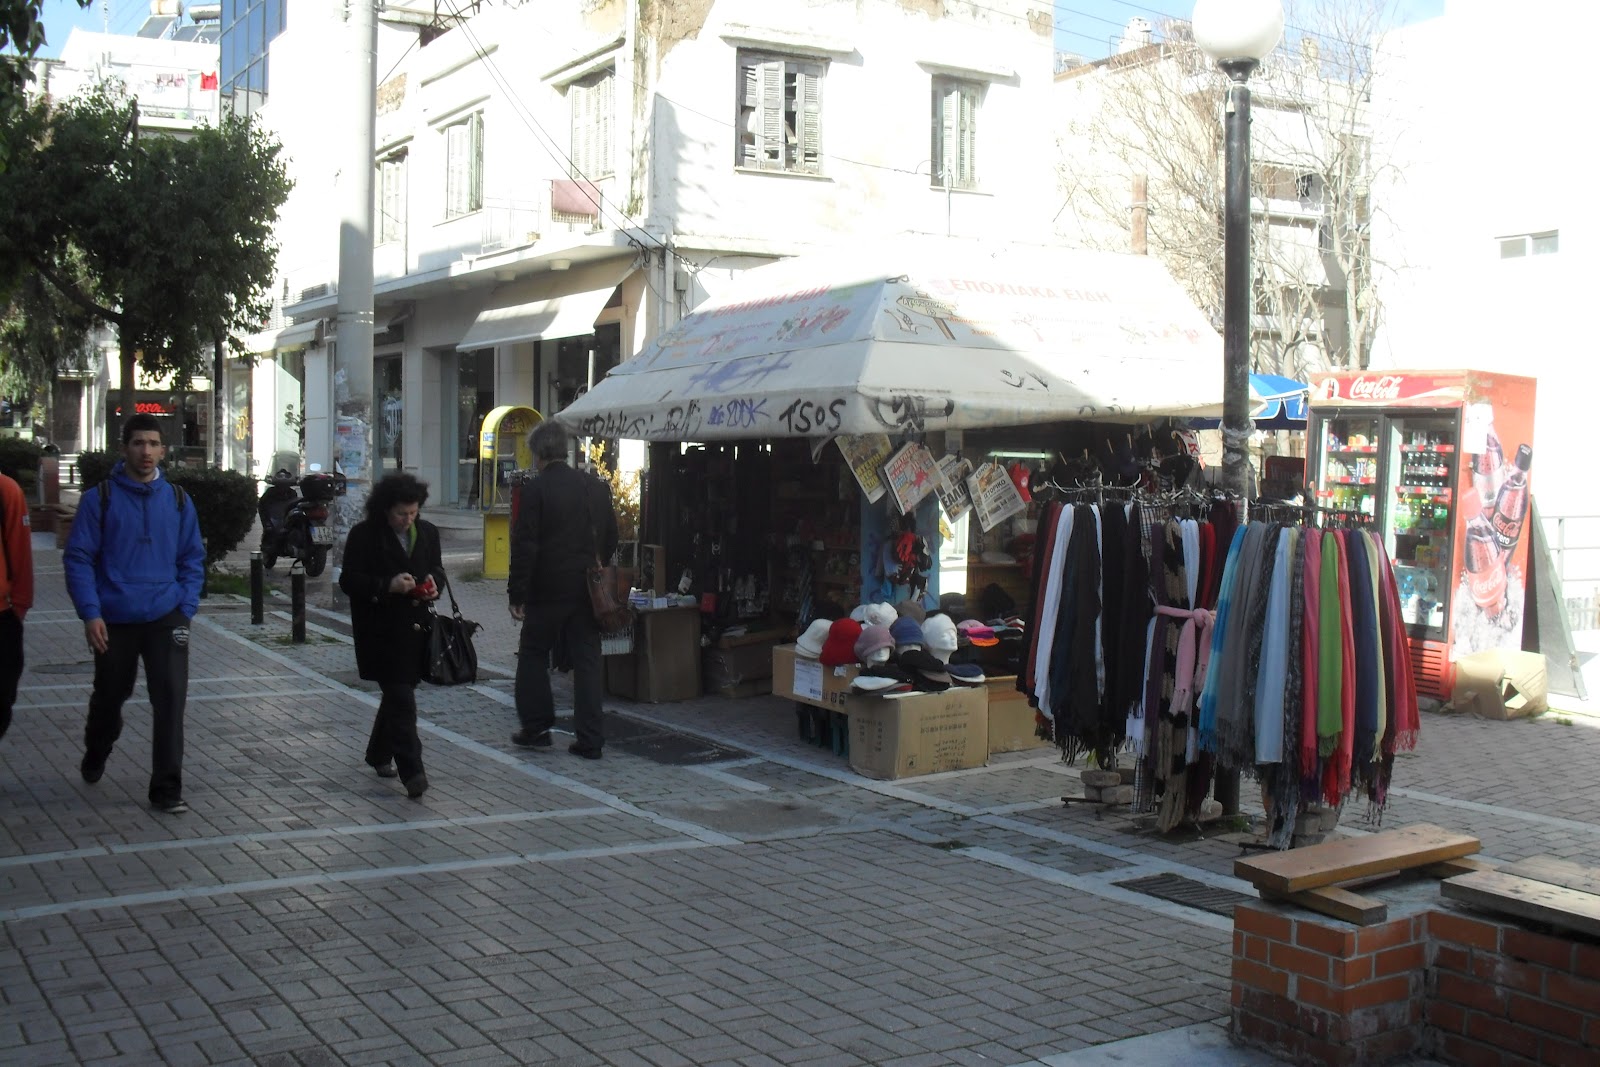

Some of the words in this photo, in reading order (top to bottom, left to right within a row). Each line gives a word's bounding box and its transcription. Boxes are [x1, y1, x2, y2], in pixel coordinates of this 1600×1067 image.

[949, 279, 1057, 298] ΕΠΟΧΙΑΚΑ
[1062, 287, 1112, 302] ΕΙΔΗ
[779, 398, 847, 432] TSOS
